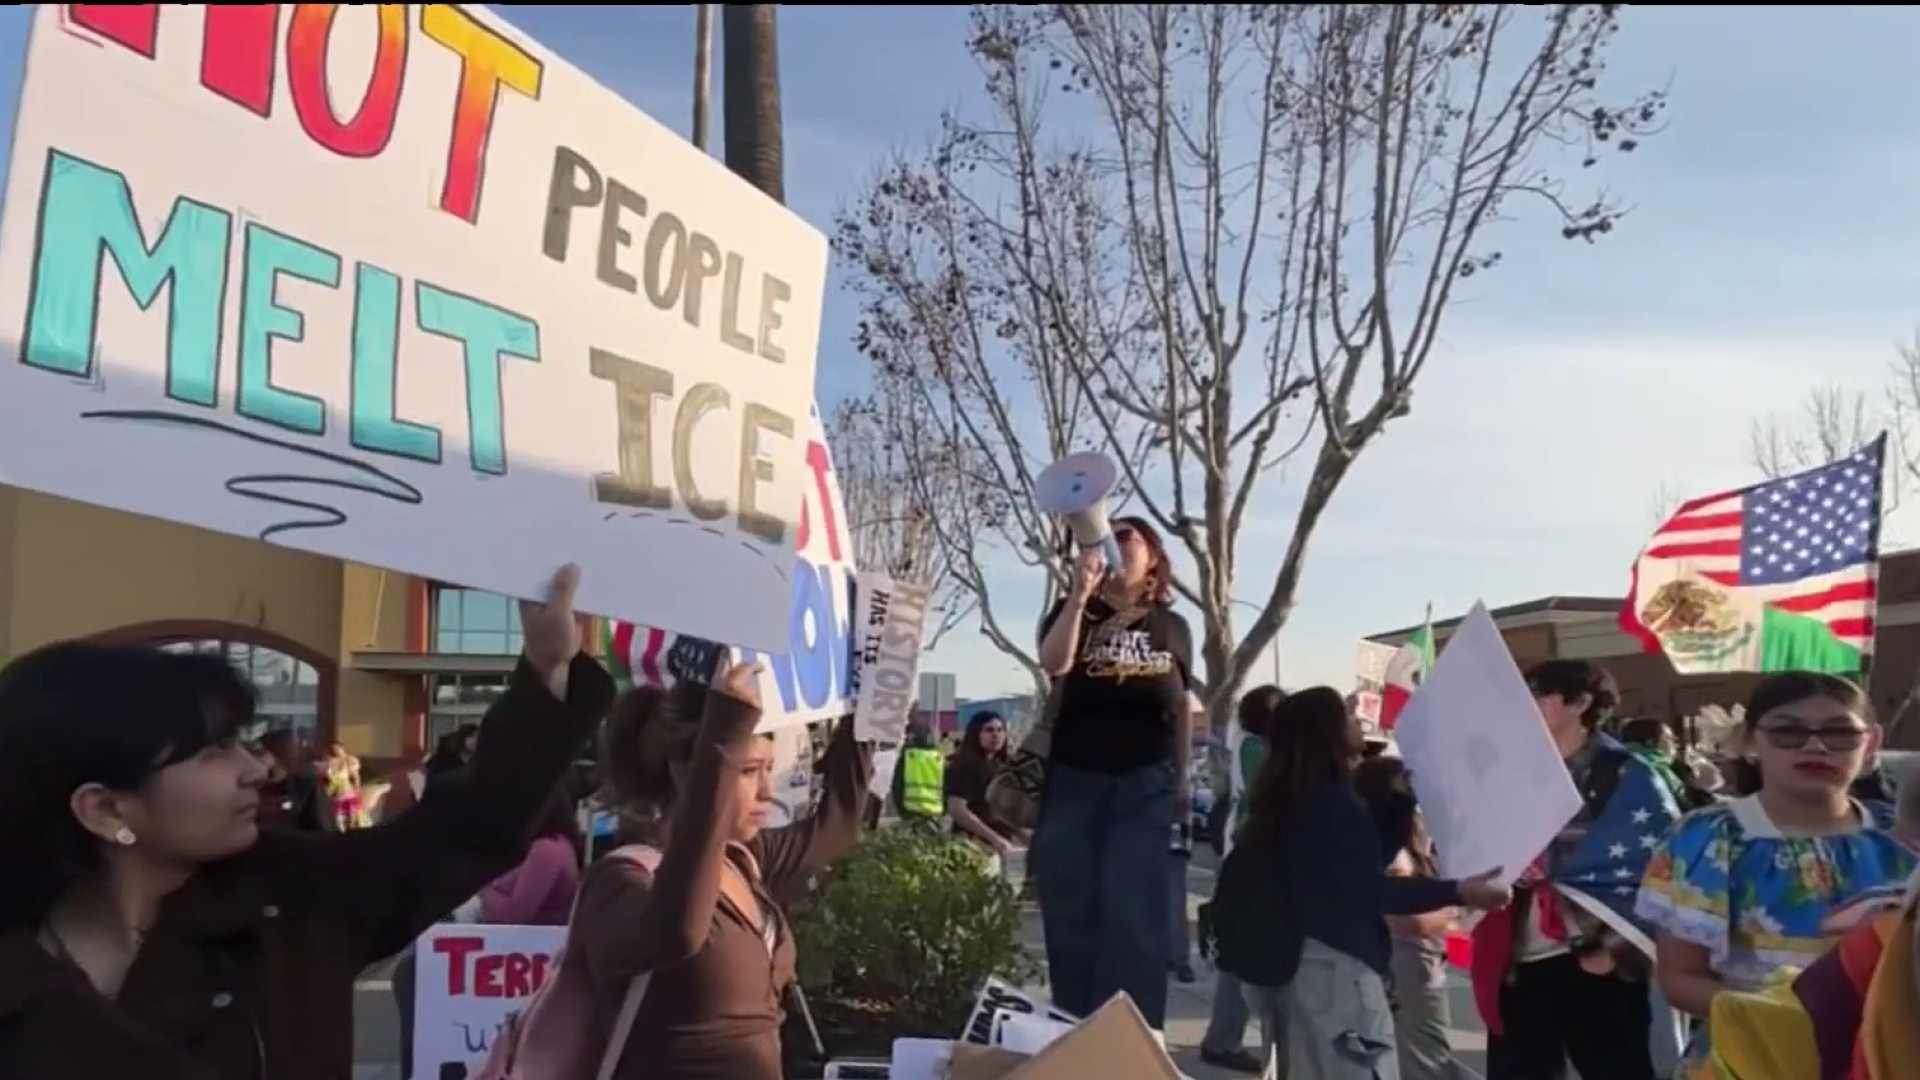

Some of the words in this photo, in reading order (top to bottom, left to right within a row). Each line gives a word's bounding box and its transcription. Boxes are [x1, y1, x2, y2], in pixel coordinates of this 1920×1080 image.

[20, 147, 541, 475] MELT
[589, 346, 795, 543] ICE
[542, 145, 791, 364] PEOPLE
[865, 635, 881, 665] ITS
